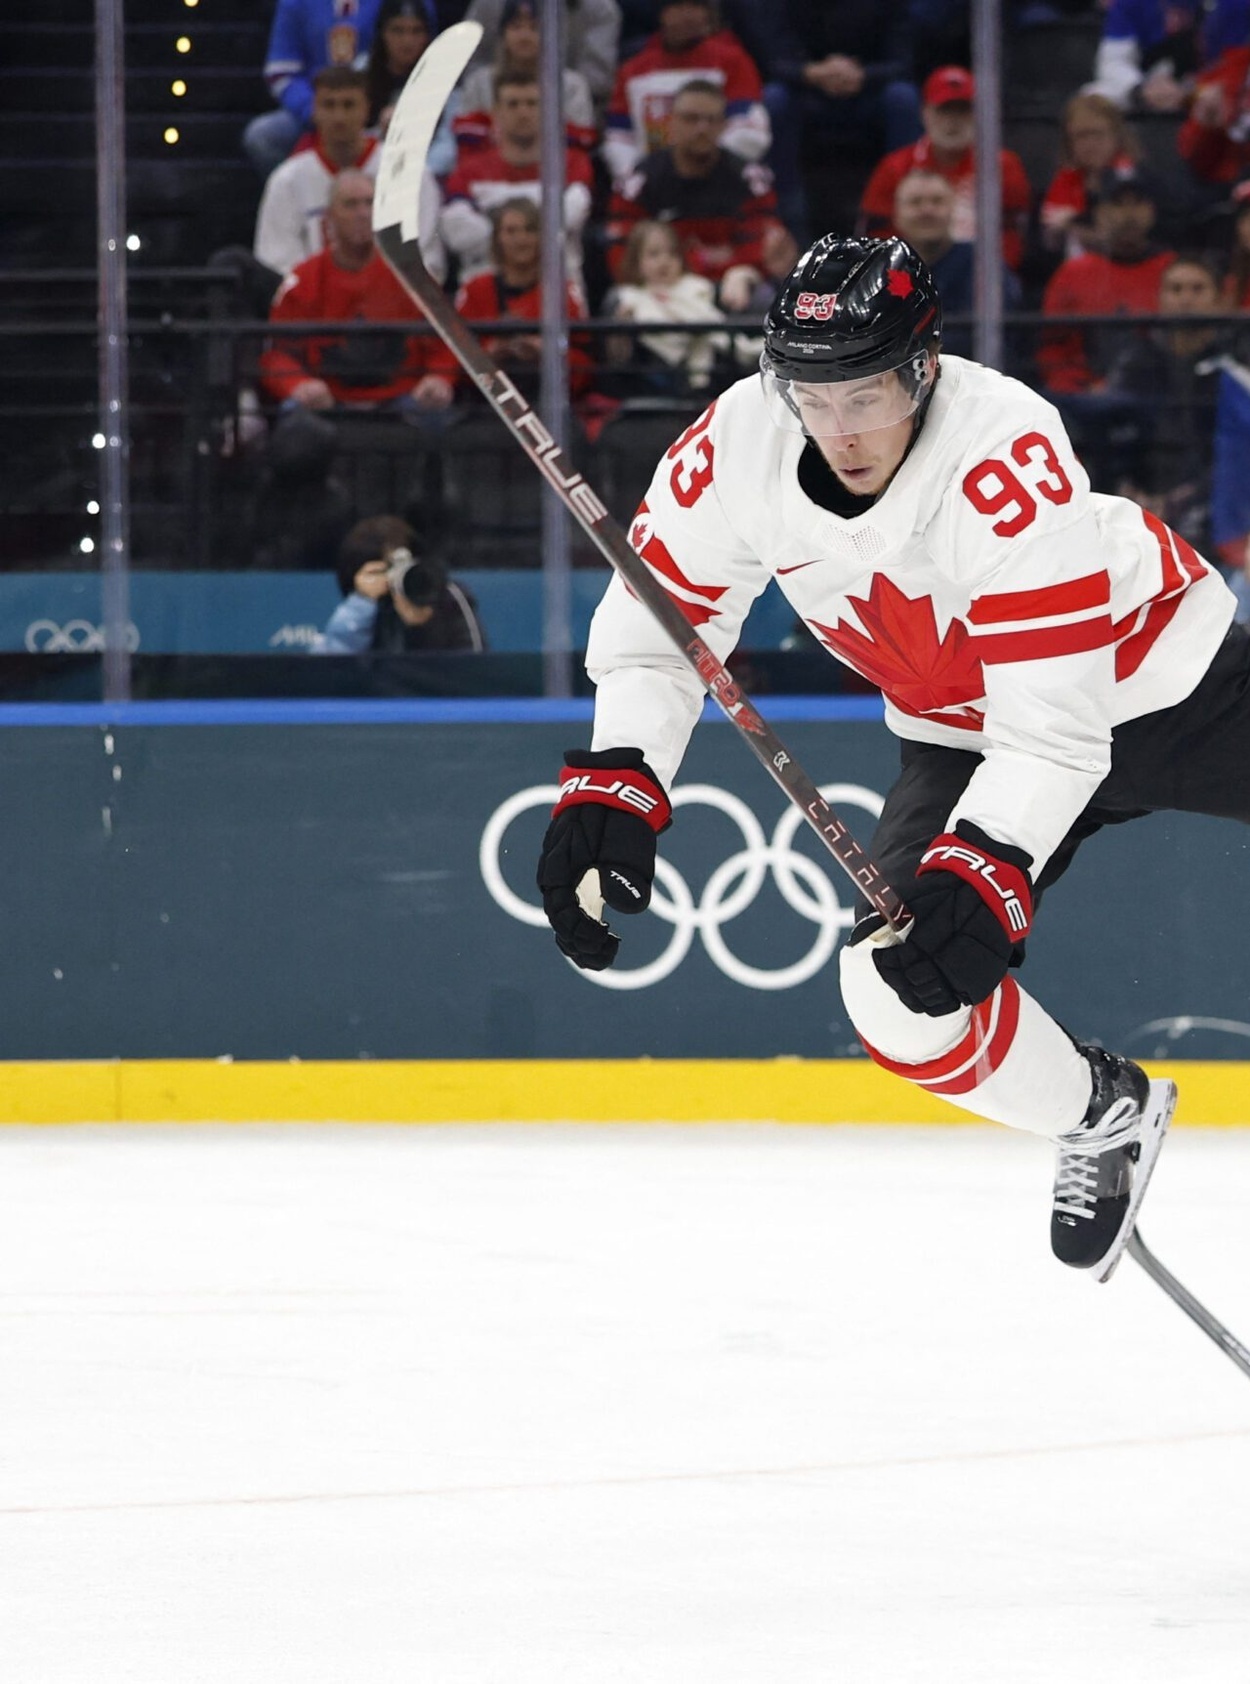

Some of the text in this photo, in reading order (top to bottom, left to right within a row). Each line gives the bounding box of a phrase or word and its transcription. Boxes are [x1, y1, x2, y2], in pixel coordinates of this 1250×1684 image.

[794, 292, 837, 320] 93
[495, 369, 609, 525] TRUE
[962, 431, 1073, 538] 93
[609, 870, 642, 899] TRUE
